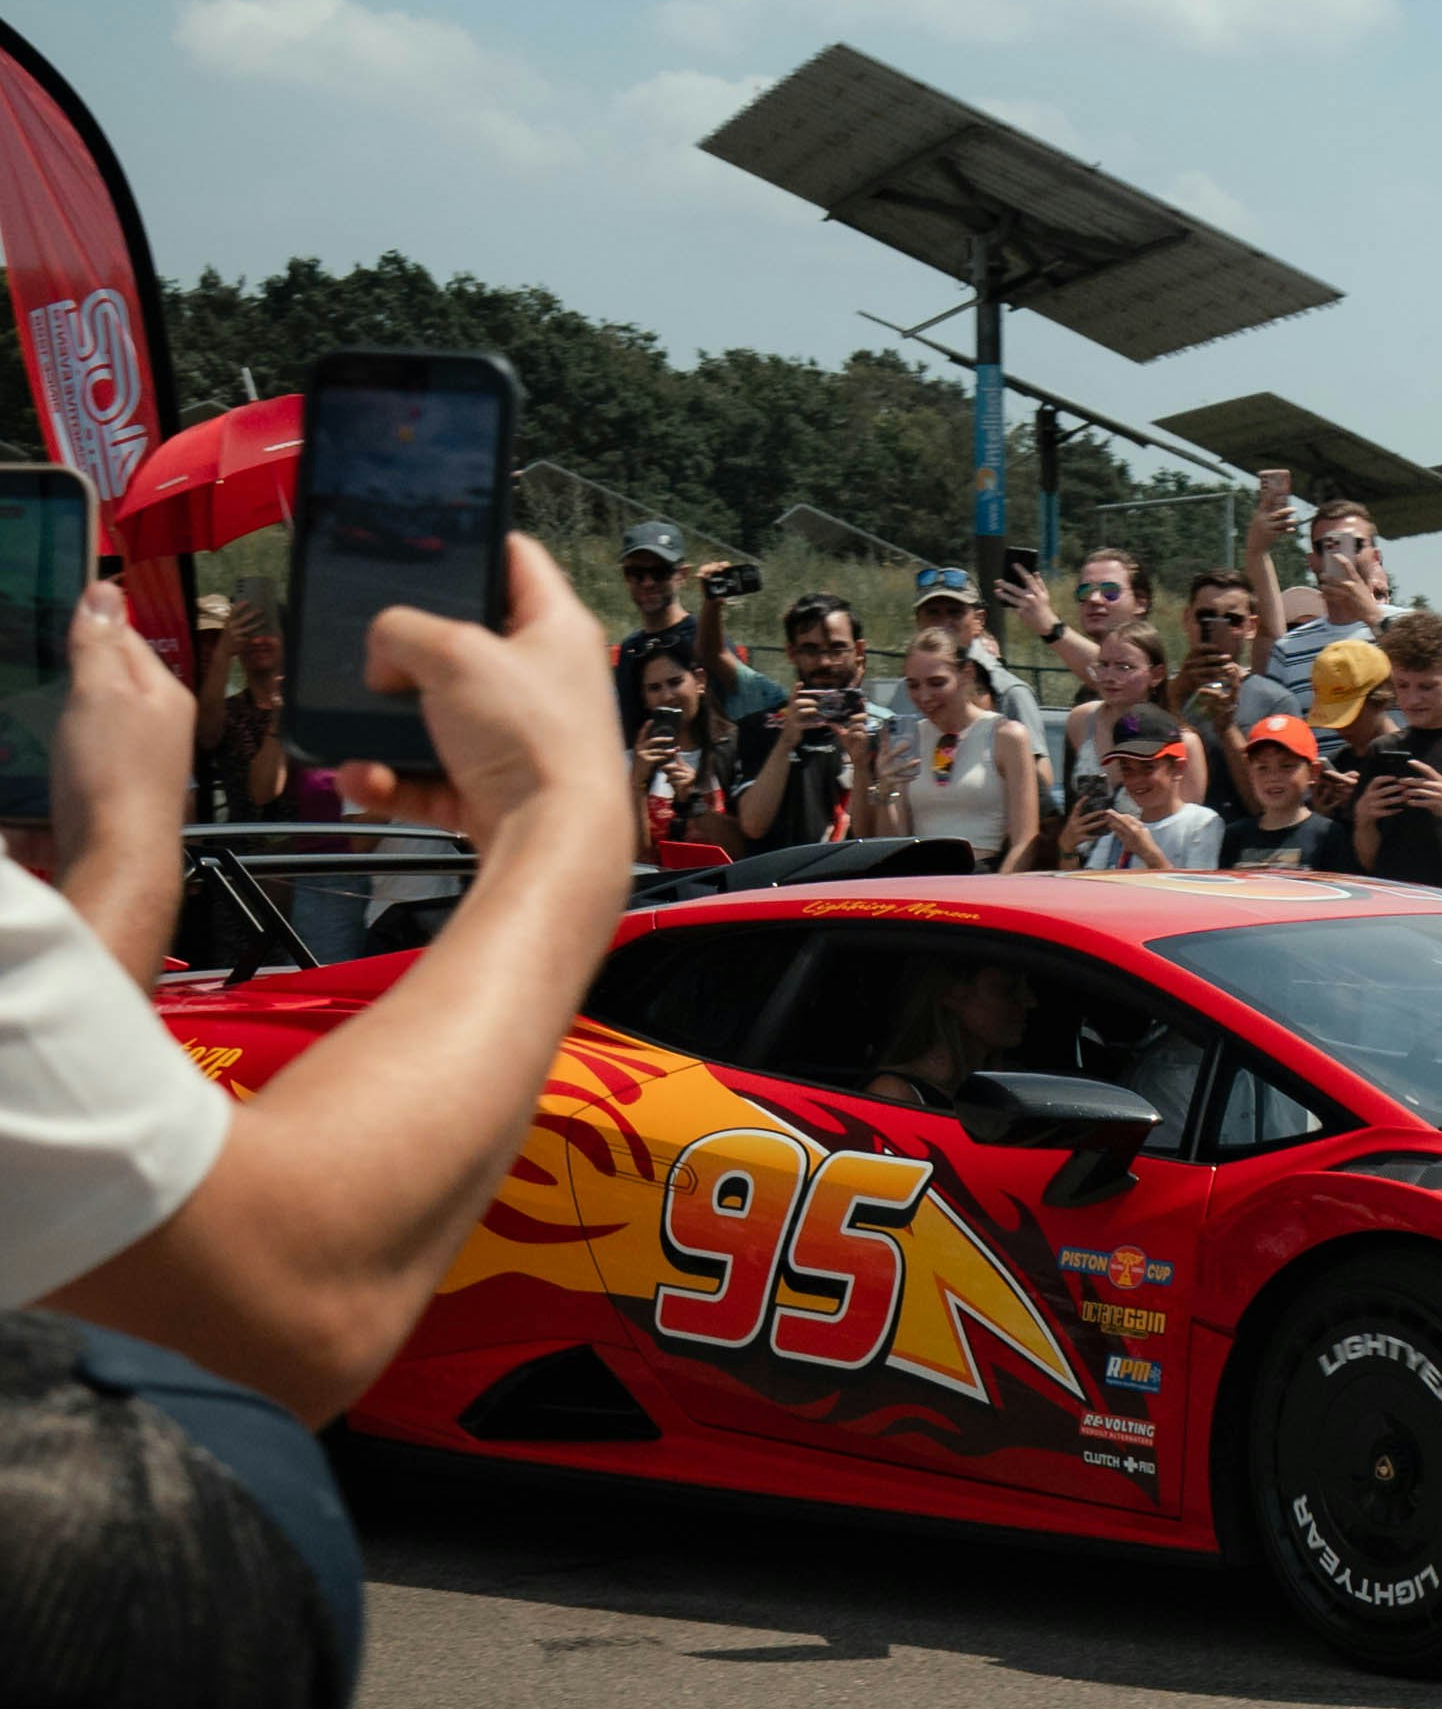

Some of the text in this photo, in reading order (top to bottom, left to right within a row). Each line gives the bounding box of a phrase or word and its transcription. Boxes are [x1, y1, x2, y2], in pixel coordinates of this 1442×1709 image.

[655, 1126, 934, 1370] 95
[1061, 1250, 1171, 1281] PISTON CUP
[1084, 1451, 1120, 1468] CLUTCH
[1293, 1494, 1440, 1606] LIGHTYEAR
